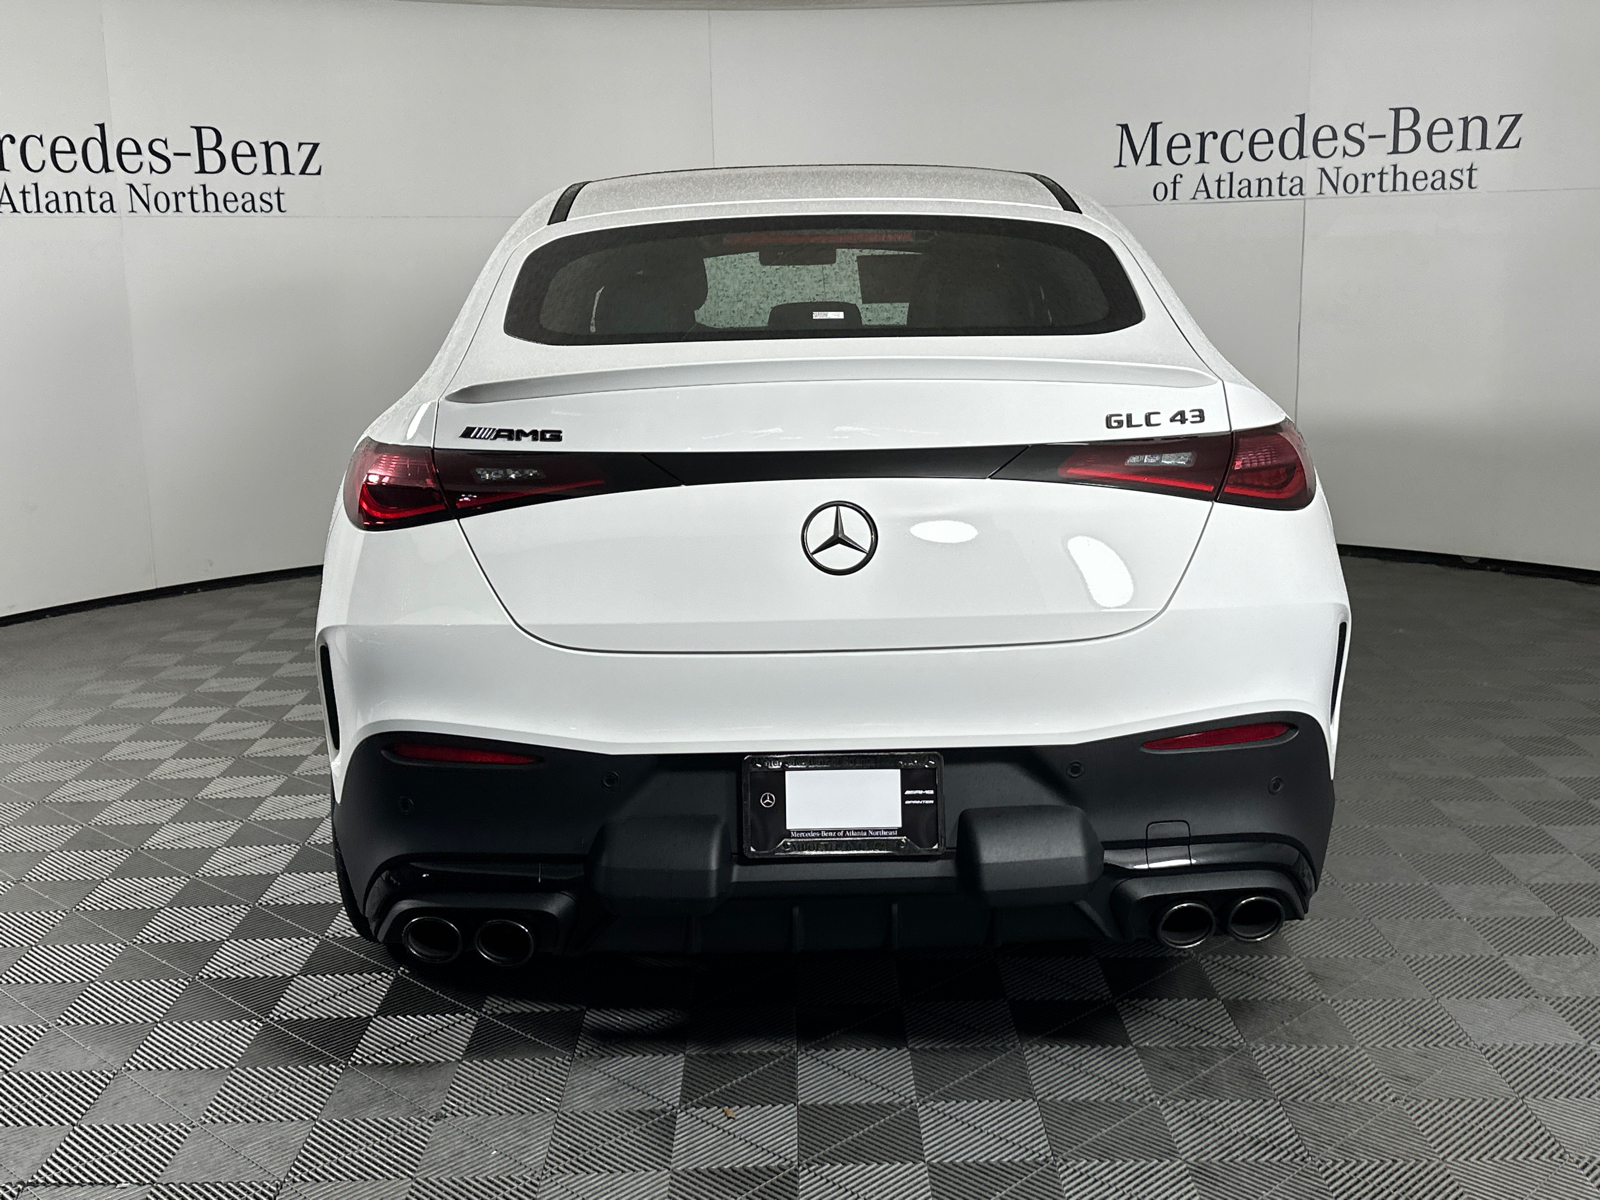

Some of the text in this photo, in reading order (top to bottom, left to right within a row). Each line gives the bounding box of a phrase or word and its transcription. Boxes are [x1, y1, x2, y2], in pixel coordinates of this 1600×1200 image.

[1114, 106, 1523, 169] Mercedes-Benz
[1152, 161, 1478, 202] of Atlanta Northeast
[0, 182, 287, 214] Atlanta Northeast
[1105, 408, 1205, 429] GLC 43
[490, 427, 563, 442] AMG
[790, 830, 836, 838] Mercedes-Benz
[868, 829, 898, 837] Northeast
